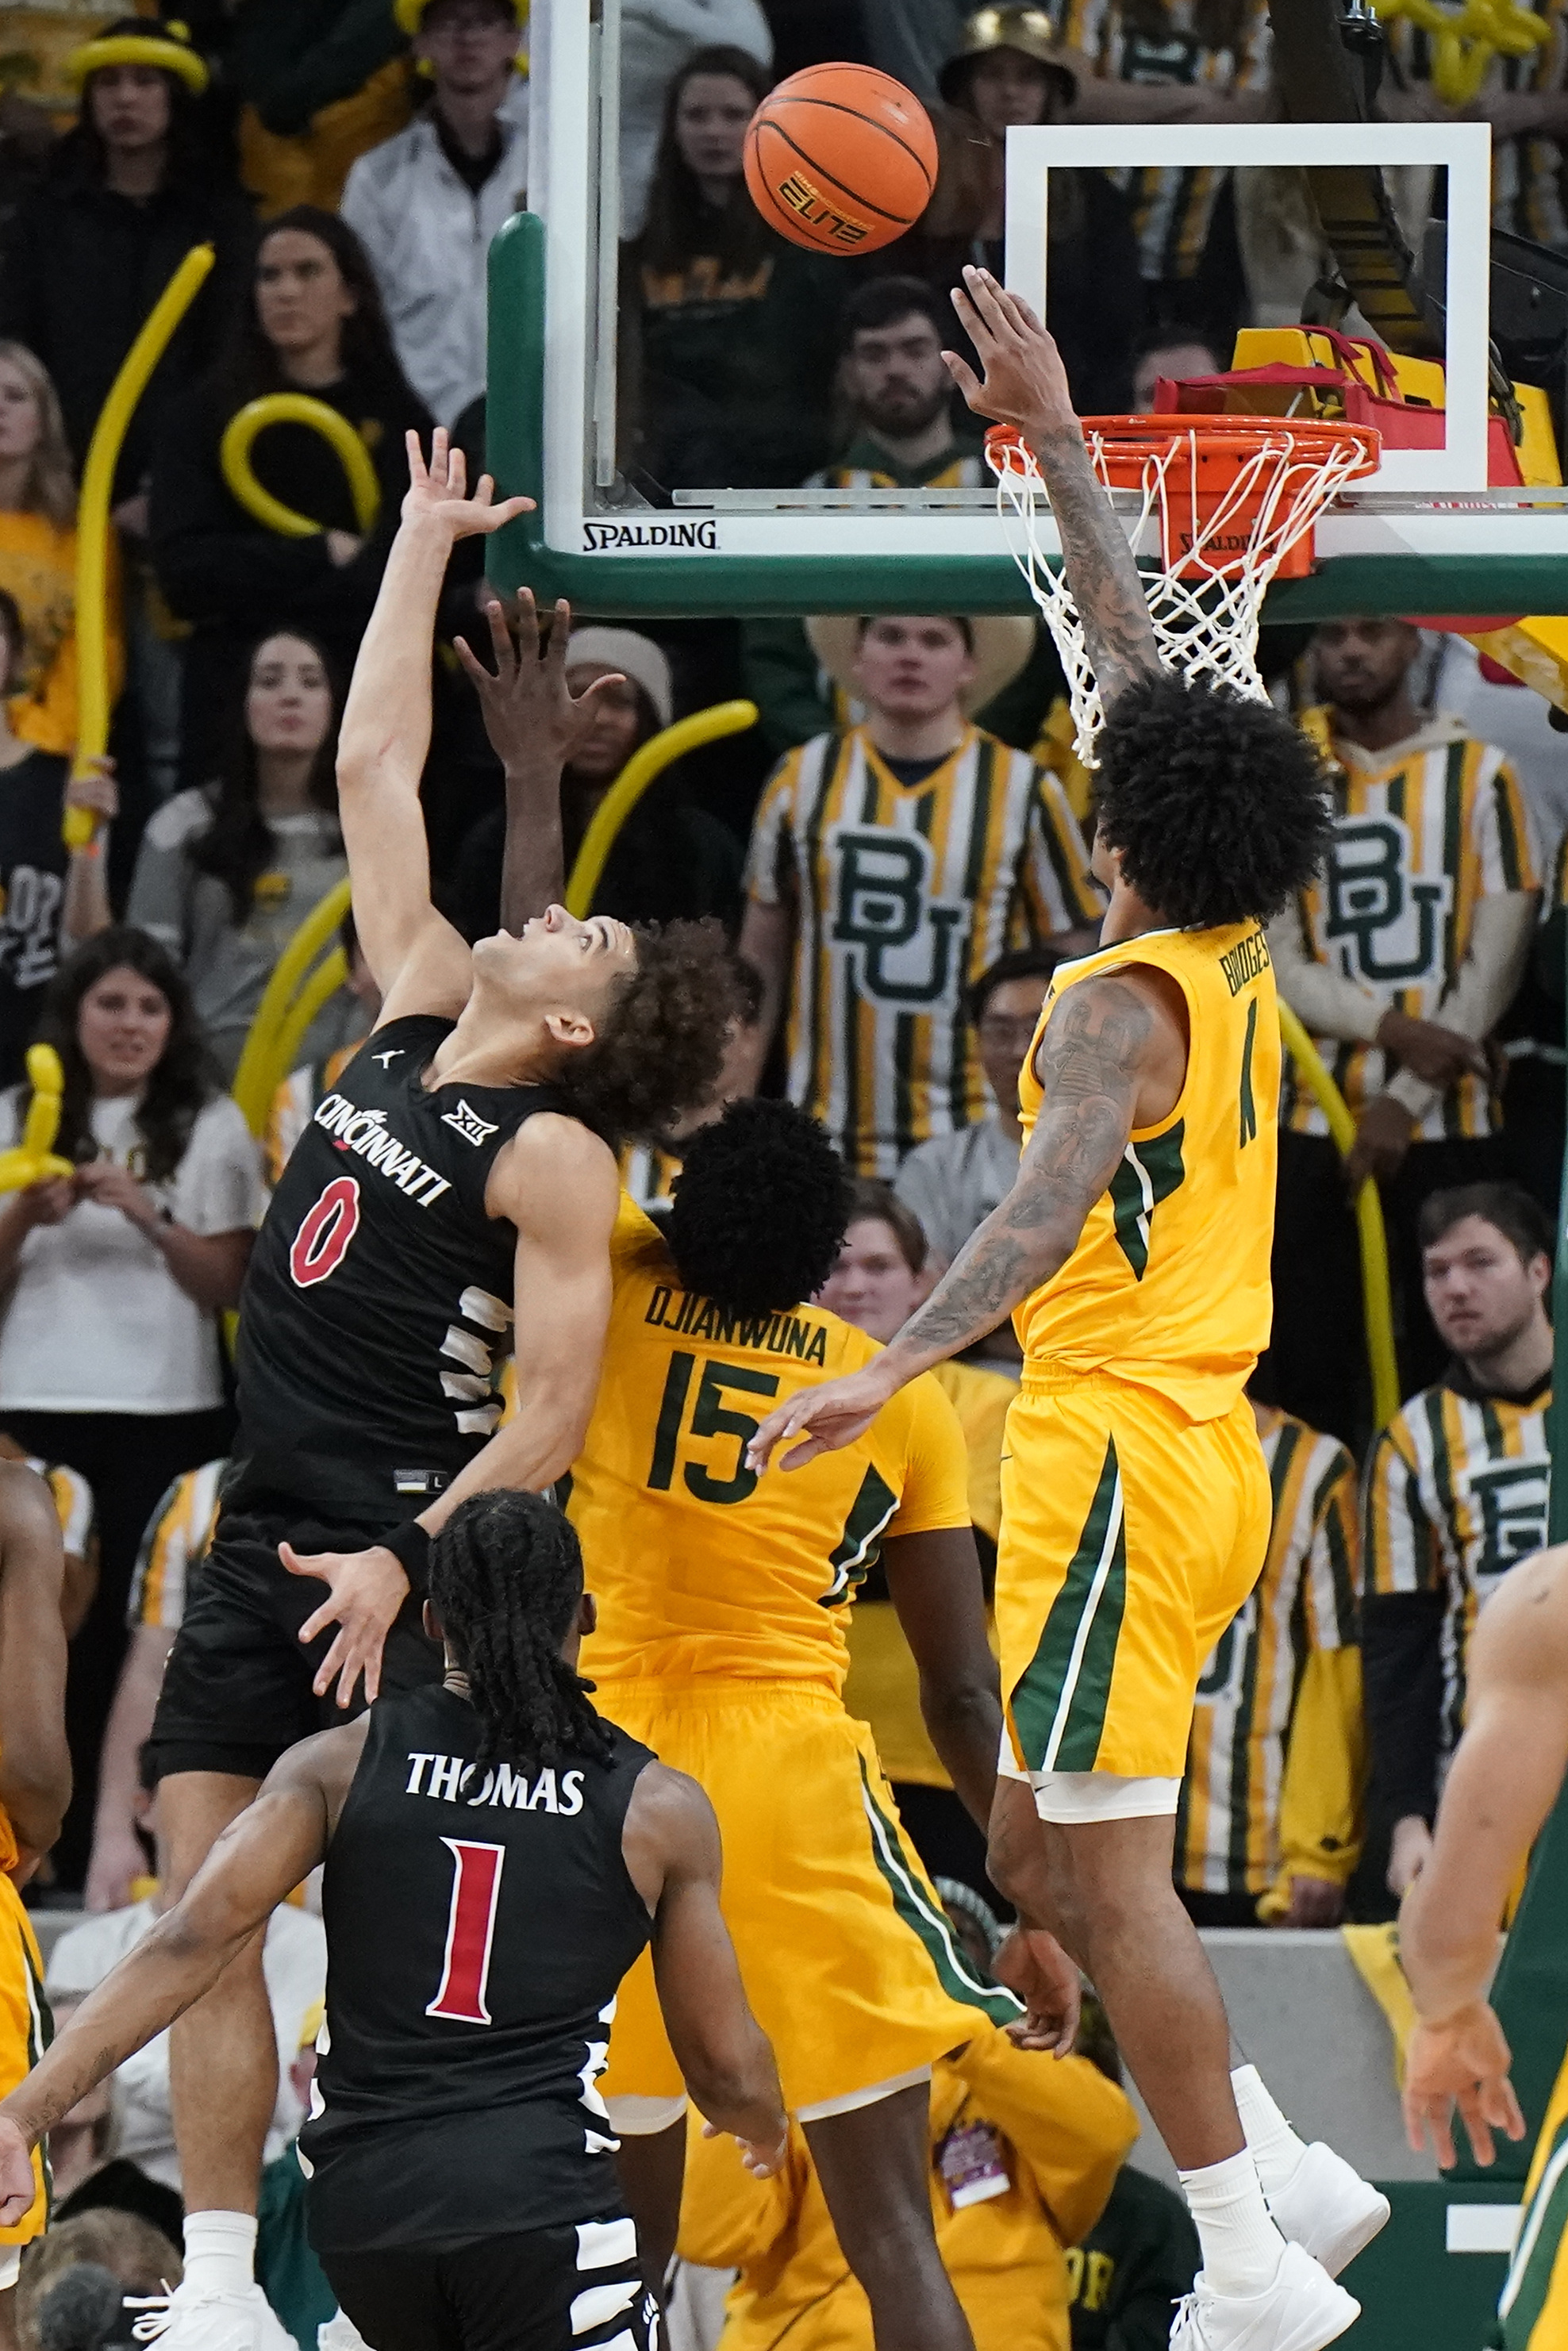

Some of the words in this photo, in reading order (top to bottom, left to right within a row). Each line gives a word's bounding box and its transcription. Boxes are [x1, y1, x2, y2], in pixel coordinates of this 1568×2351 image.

[778, 175, 869, 245] ELITE
[582, 519, 717, 552] SPALDING
[1180, 532, 1279, 555] SALDIG
[832, 833, 963, 1002] BU
[1327, 822, 1443, 979] BU
[1219, 931, 1270, 997] BRIDGES
[314, 1093, 452, 1208] CINCINNATI
[290, 1176, 360, 1288] 0
[647, 1350, 781, 1505] 15
[405, 1752, 586, 1816] THOMAS
[425, 1836, 506, 2026] 1
